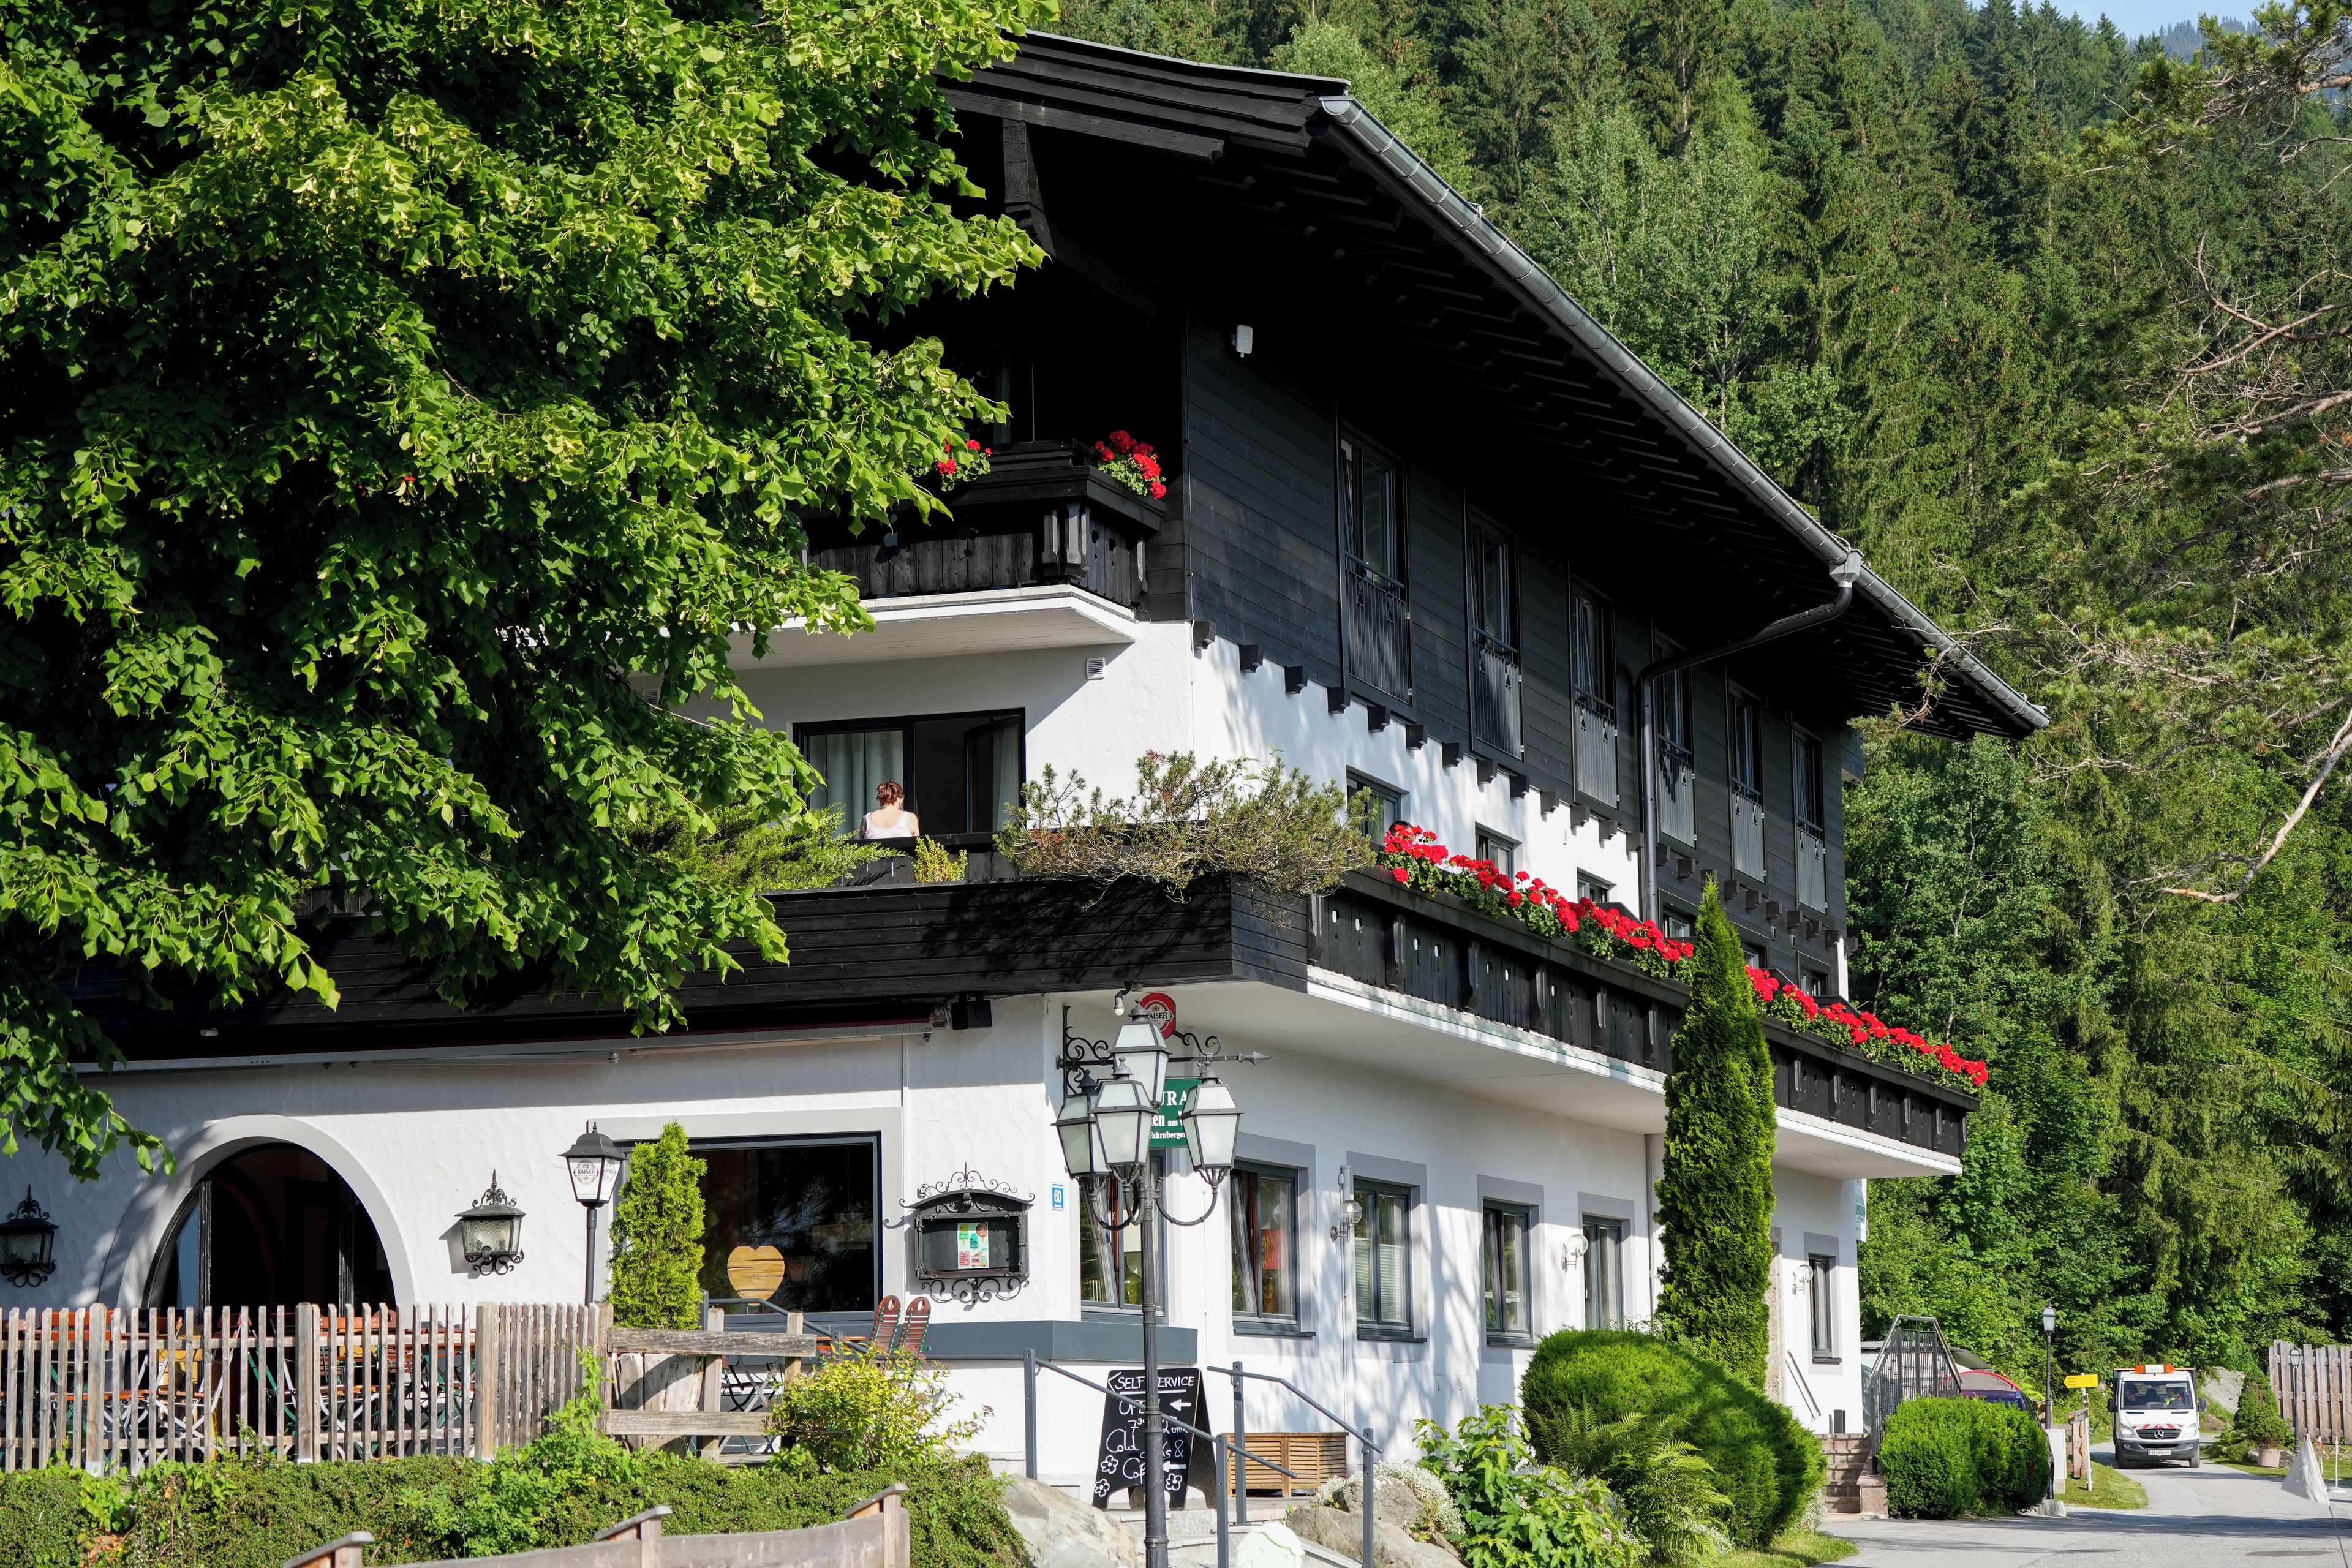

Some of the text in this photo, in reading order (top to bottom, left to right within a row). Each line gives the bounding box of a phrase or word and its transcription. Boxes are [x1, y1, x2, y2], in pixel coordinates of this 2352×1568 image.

[1054, 1189, 1062, 1204] 60
[1115, 1376, 1195, 1390] SELF ERVICE
[1106, 1429, 1140, 1453] Cold
